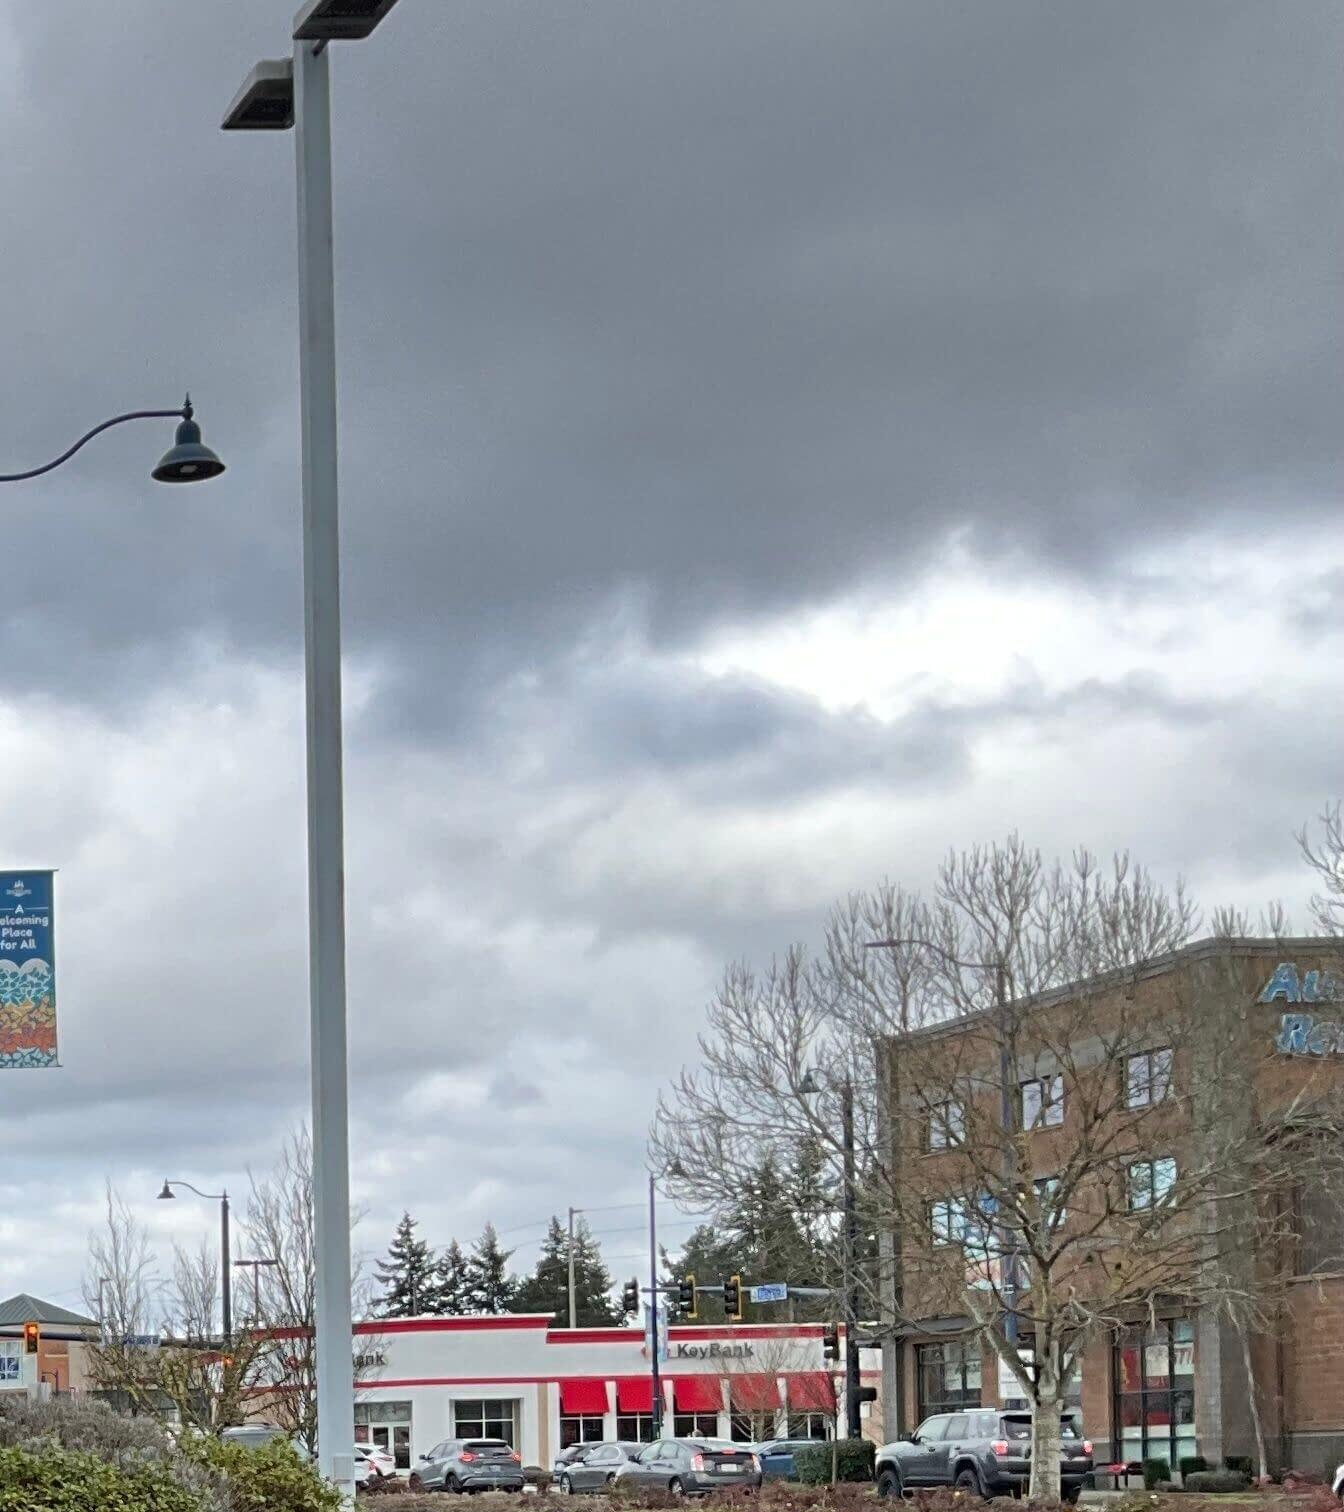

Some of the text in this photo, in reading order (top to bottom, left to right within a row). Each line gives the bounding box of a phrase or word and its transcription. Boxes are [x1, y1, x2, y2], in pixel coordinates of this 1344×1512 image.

[14, 904, 25, 914] A
[1, 927, 33, 938] Place
[0, 938, 37, 950] for All
[677, 1342, 754, 1359] KeyBank
